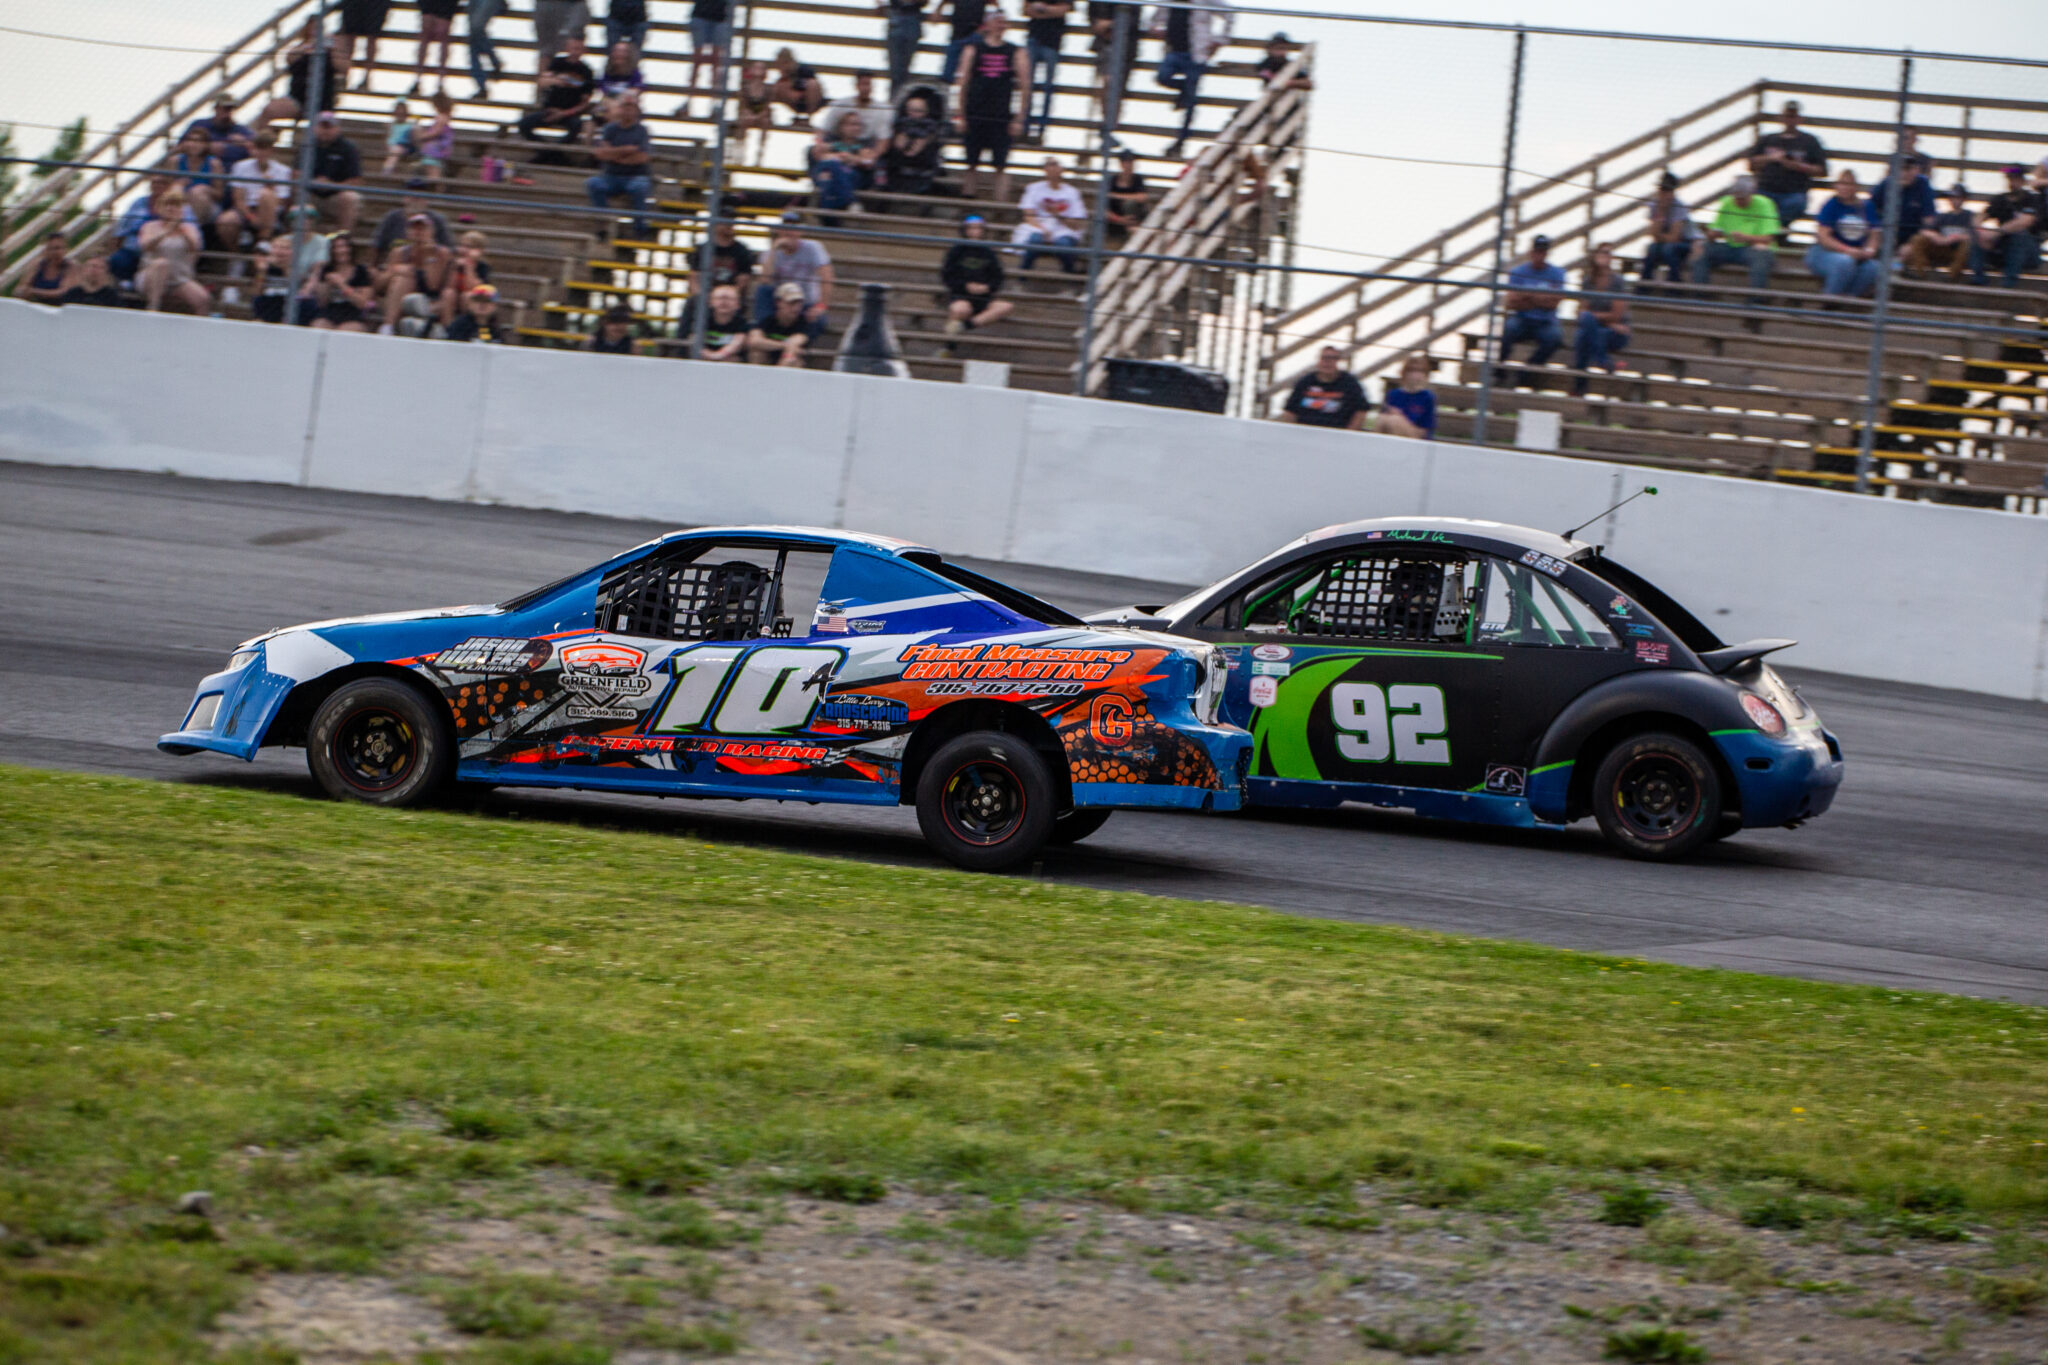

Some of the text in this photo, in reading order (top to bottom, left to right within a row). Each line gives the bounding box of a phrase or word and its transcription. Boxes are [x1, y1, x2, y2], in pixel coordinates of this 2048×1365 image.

[901, 643, 1131, 663] Final Measure
[902, 661, 1112, 680] CONTRACTING
[561, 676, 647, 689] GREENFIELD
[654, 647, 842, 732] 10
[834, 693, 859, 704] Little
[1090, 694, 1133, 745] G
[1330, 681, 1453, 765] 92
[722, 743, 828, 760] RACING
